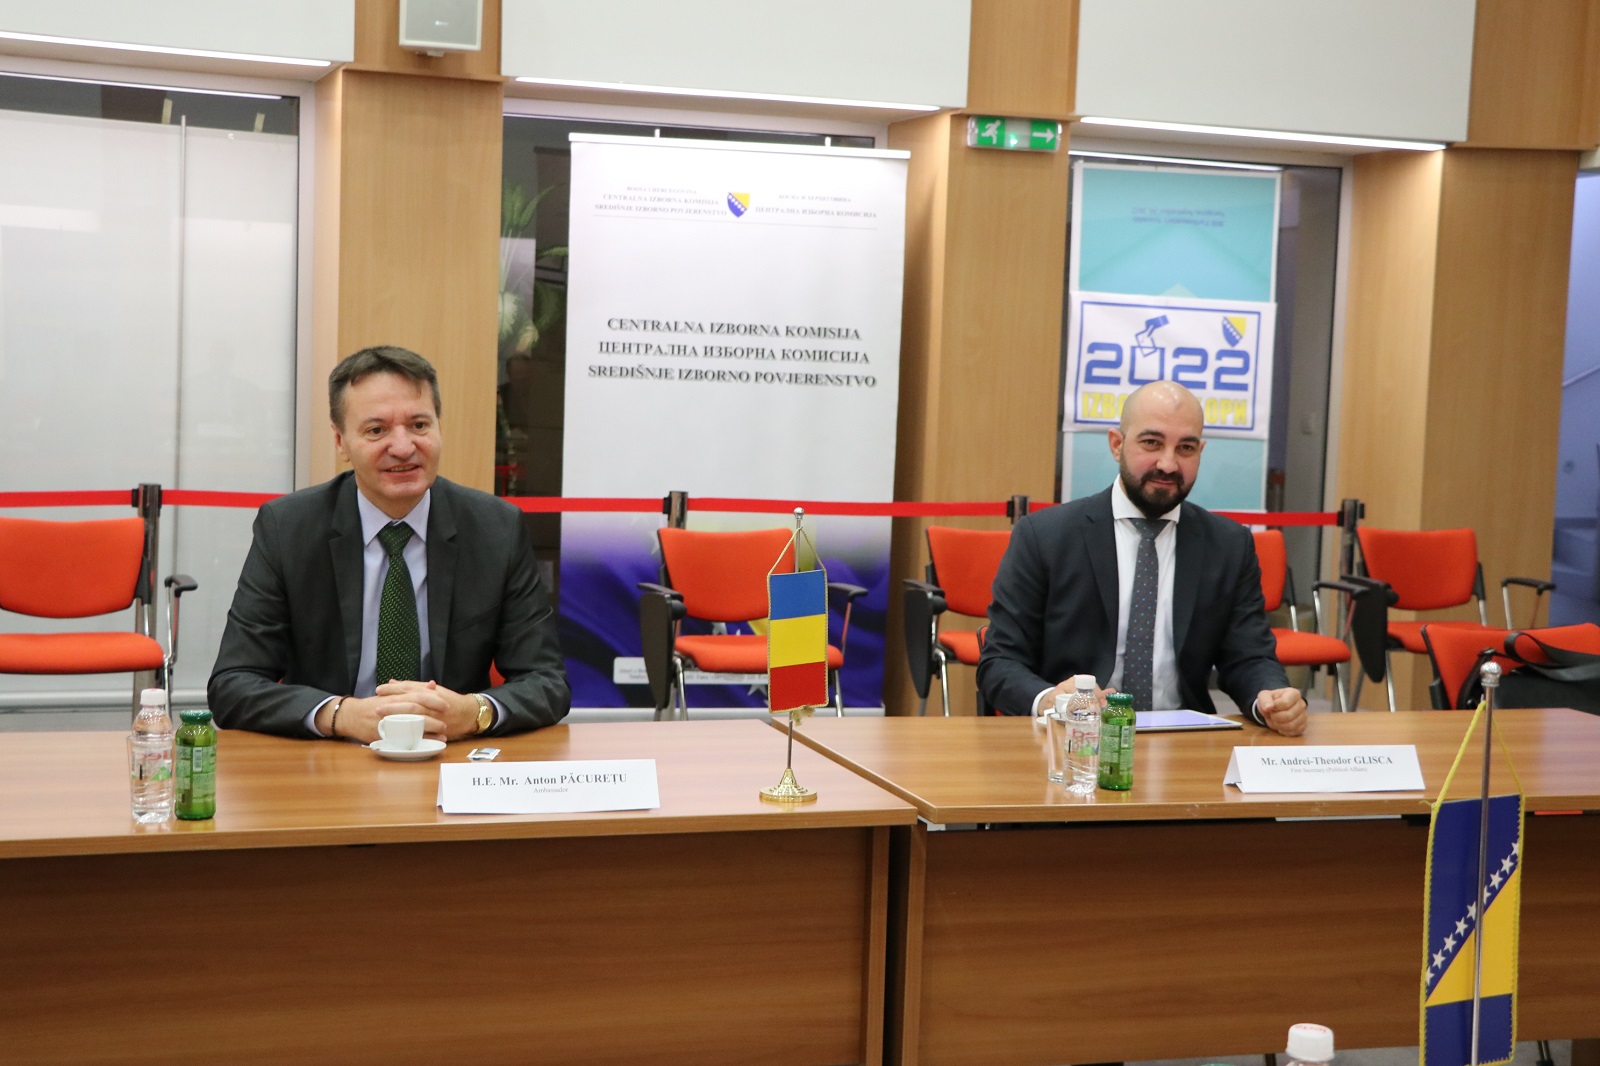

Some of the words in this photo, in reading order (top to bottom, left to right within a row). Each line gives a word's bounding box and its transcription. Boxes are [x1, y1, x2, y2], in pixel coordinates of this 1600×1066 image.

[603, 193, 648, 202] CENTRALNA
[649, 196, 682, 204] IZBORNA
[635, 206, 669, 214] IZBORNO
[670, 207, 728, 217] POVJERENSTVO
[607, 317, 705, 334] CENTRALNA
[709, 322, 781, 338] IZBORNA
[785, 325, 862, 341] KOMISIJA
[598, 341, 699, 358] ЦЕНТРАЛНА
[702, 345, 777, 361] ИЗБОРНА
[781, 348, 870, 364] КОМИСИЈА
[1084, 342, 1250, 391] 2022
[588, 363, 675, 381] SREDIŠNJE
[678, 368, 751, 384] IZBORNO
[754, 371, 878, 388] POVJERENSTVO
[1261, 757, 1278, 766] Mr.
[1280, 756, 1352, 766] Andrei-Theodor
[1353, 756, 1393, 765] GLISCA
[472, 776, 496, 786] H.E.
[499, 776, 519, 786] Mr.
[524, 775, 557, 786] Anton
[533, 786, 569, 794] Ambassador
